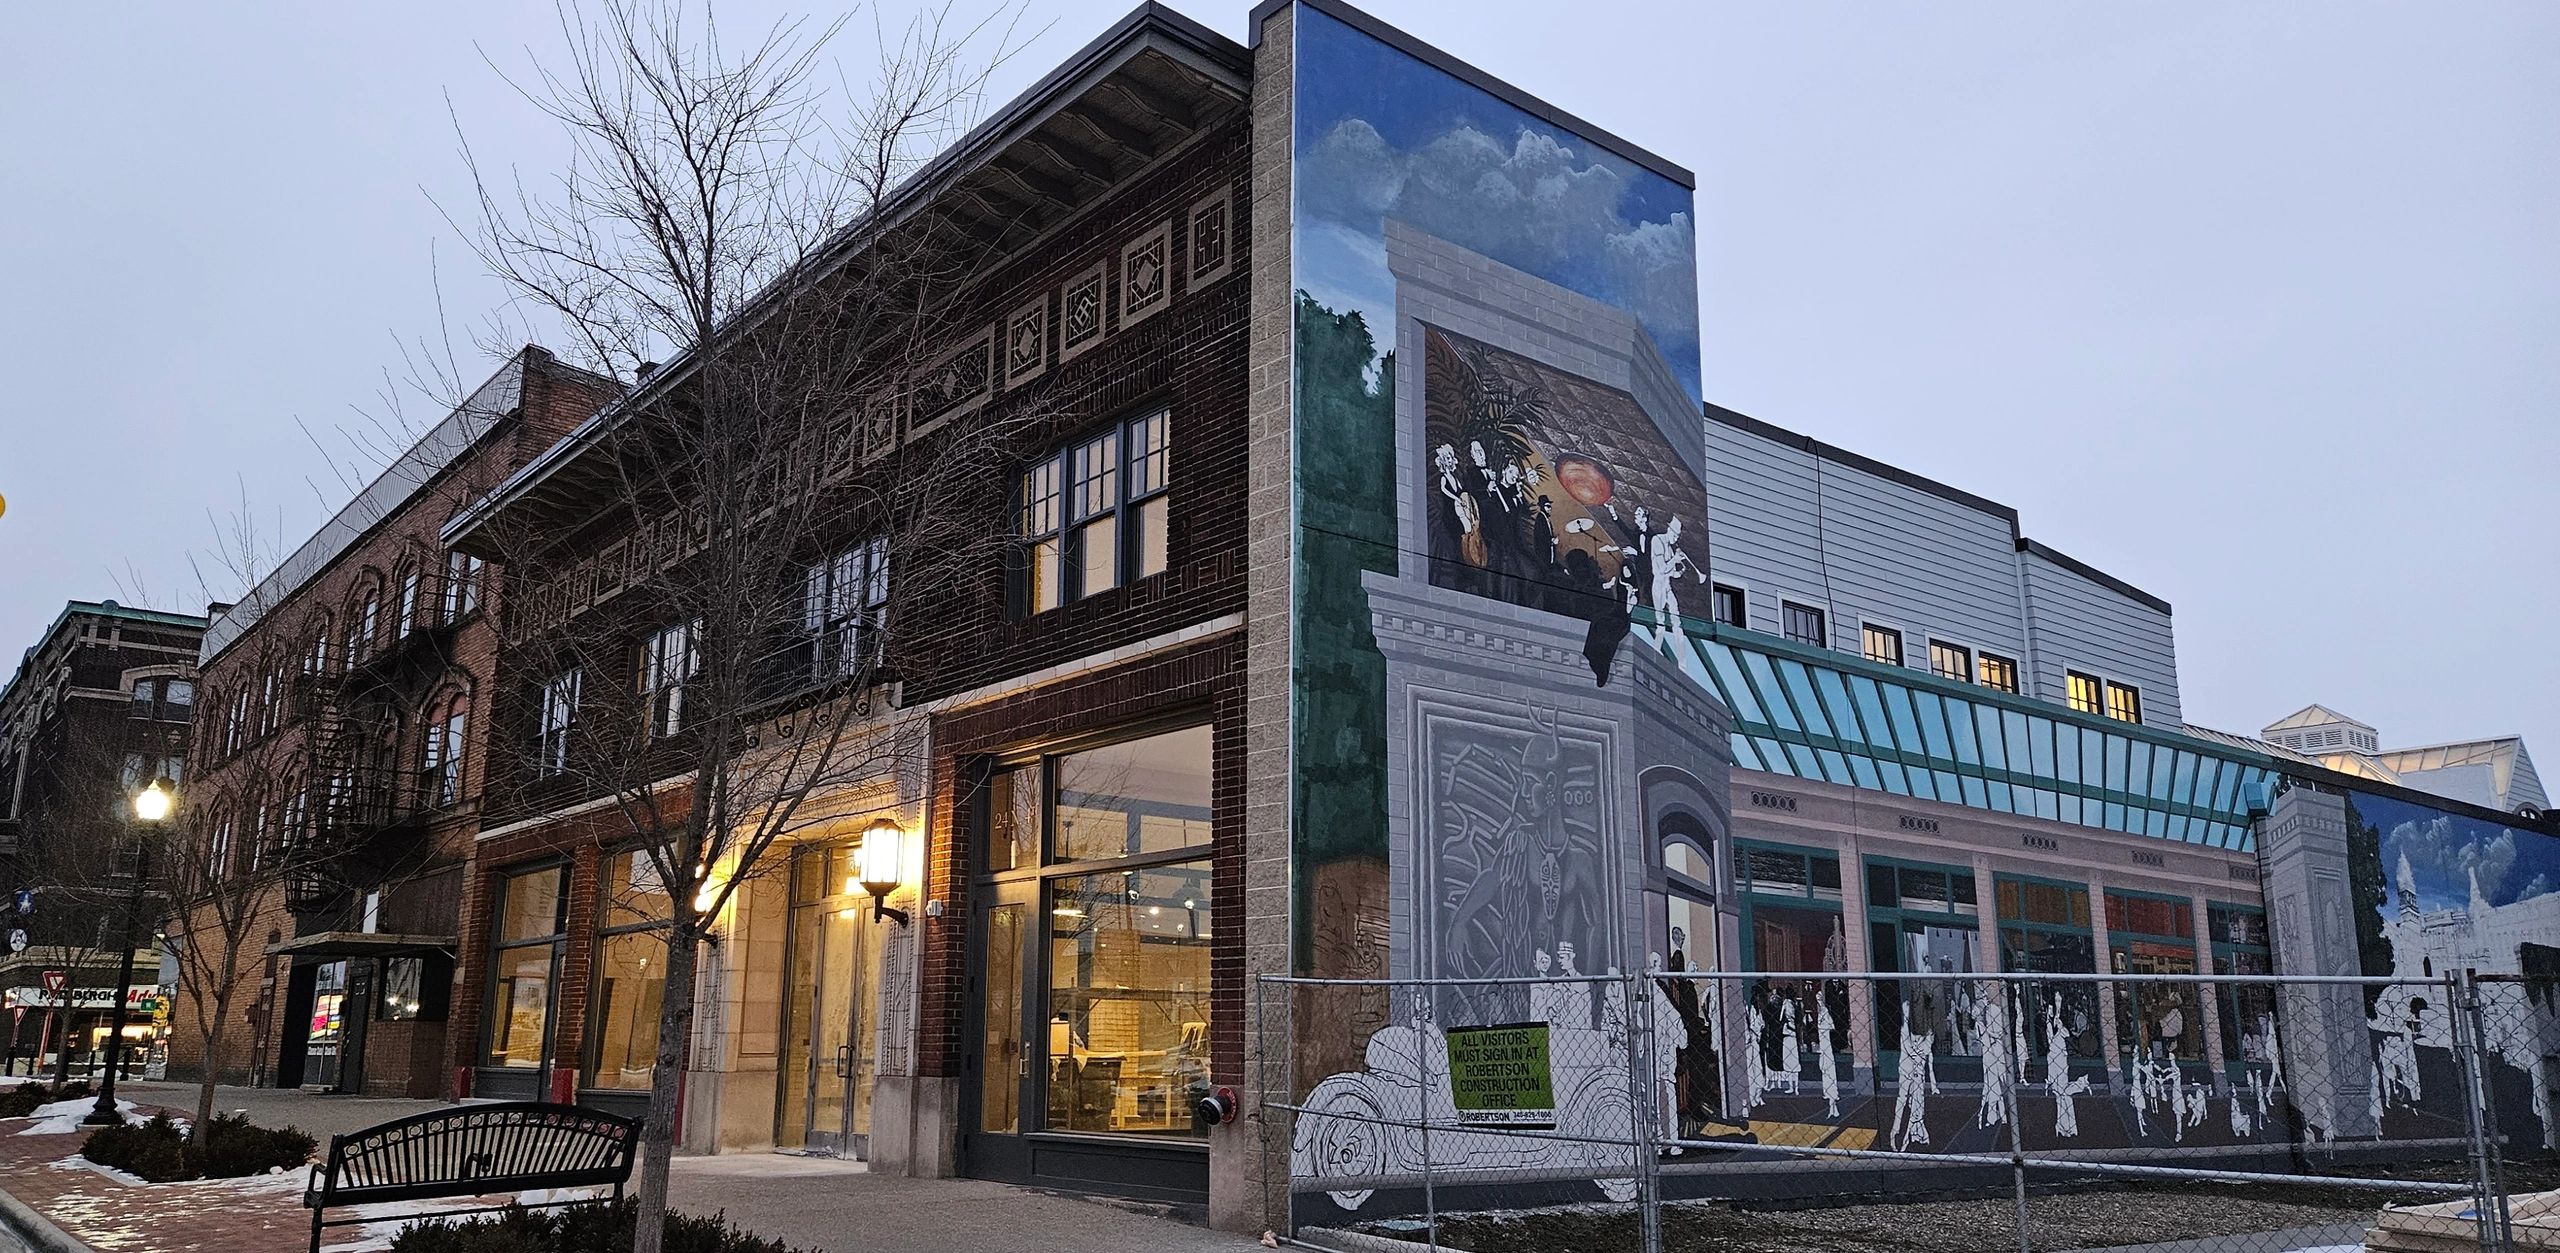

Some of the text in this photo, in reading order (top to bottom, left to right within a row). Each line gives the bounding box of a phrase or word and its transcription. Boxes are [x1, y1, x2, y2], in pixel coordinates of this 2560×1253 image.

[994, 811, 1008, 829] 24
[1461, 1031, 1529, 1047] ALL VISITORS
[1454, 1046, 1539, 1063] MUST SIGN IN AT
[1465, 1062, 1530, 1077] ROBERTSON
[1460, 1077, 1540, 1093] CONSTRUCTION
[1482, 1093, 1517, 1107] OFFICE
[1465, 1111, 1511, 1122] ROBERTSON
